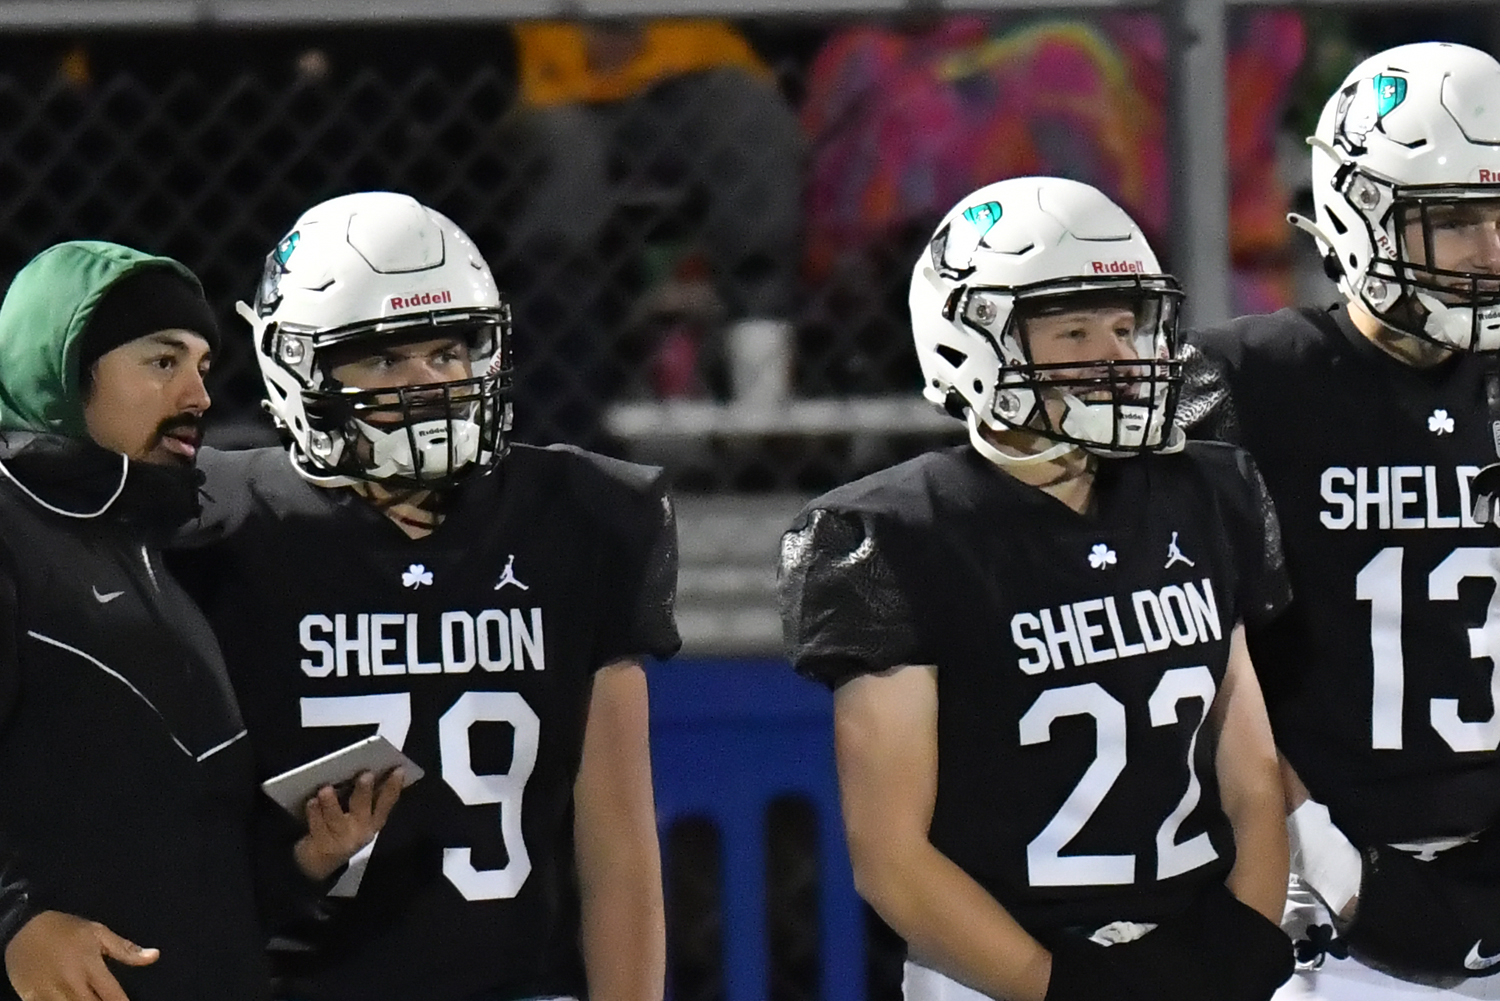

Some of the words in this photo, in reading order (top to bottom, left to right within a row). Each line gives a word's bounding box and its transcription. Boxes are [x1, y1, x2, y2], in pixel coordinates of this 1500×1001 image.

[390, 290, 452, 310] Riddell
[1091, 260, 1145, 274] Riddell
[418, 426, 448, 437] Riddel
[300, 607, 545, 678] SHELDON
[1010, 577, 1223, 675] SHELDON
[300, 690, 541, 902] 79
[1018, 665, 1220, 887] 22
